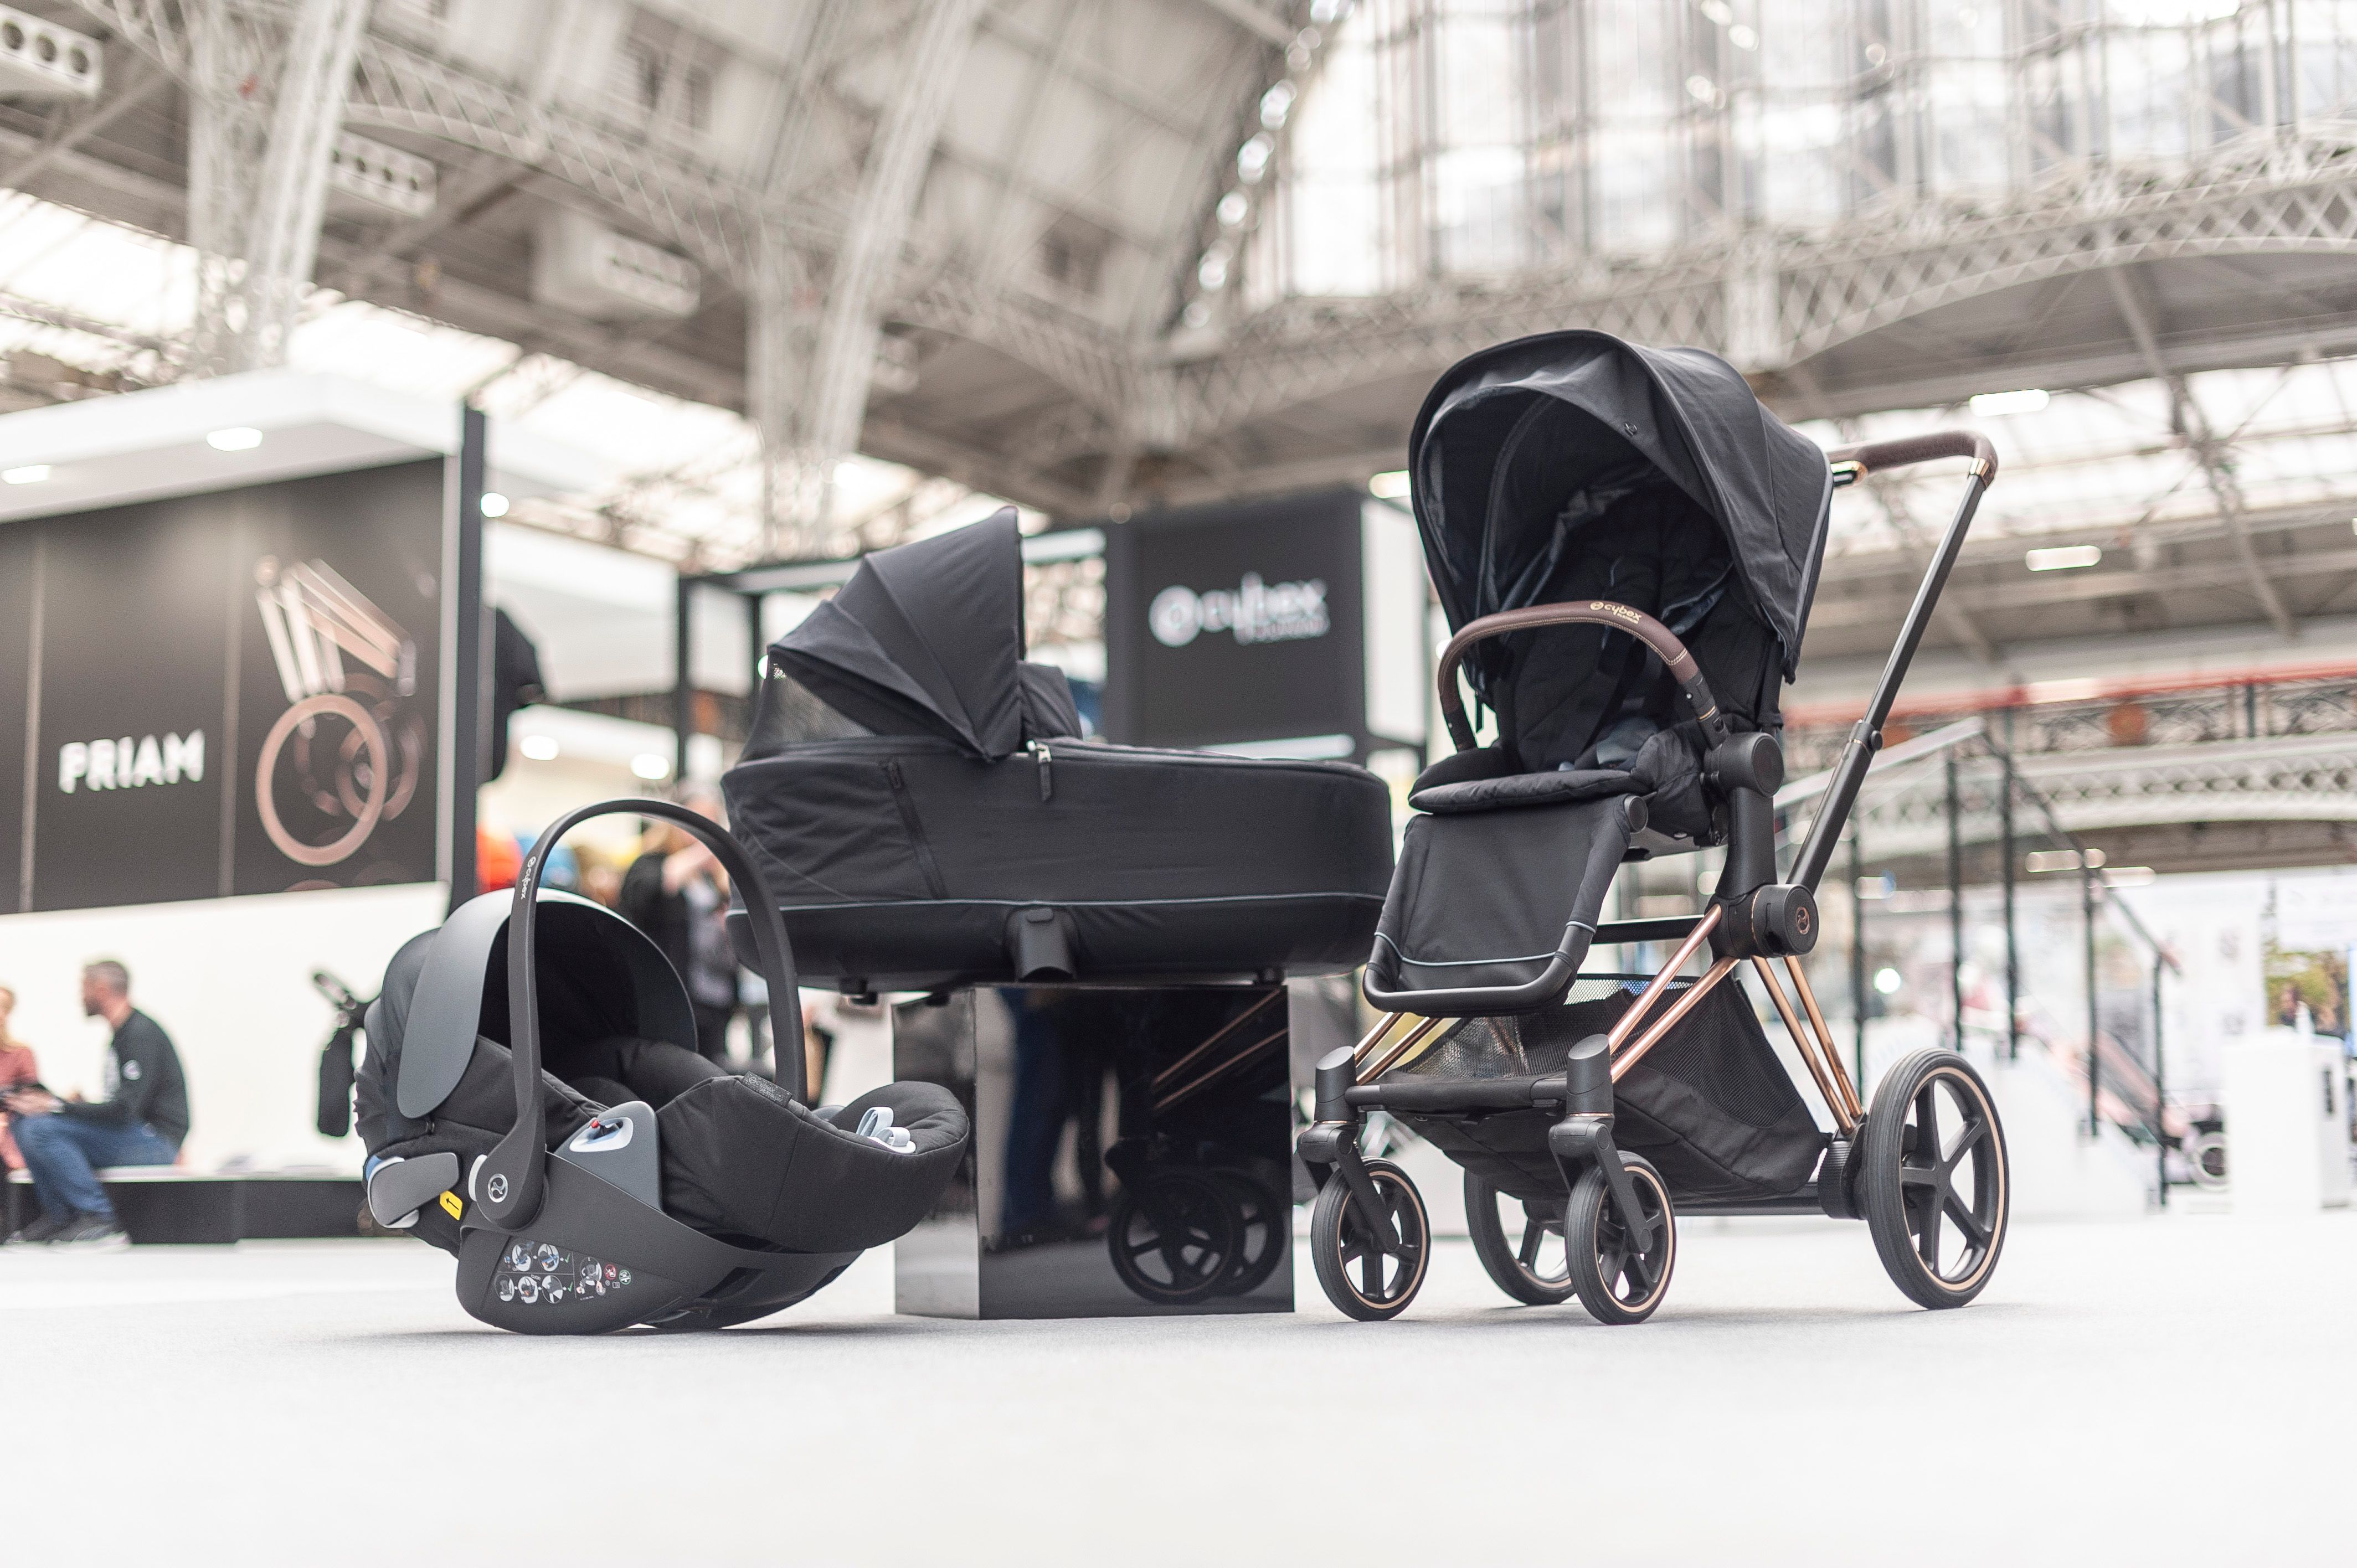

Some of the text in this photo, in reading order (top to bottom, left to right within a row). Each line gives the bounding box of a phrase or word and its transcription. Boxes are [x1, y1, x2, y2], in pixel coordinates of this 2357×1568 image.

[1604, 604, 1641, 621] cybex
[58, 729, 205, 794] PRIAM
[521, 868, 531, 900] cybex
